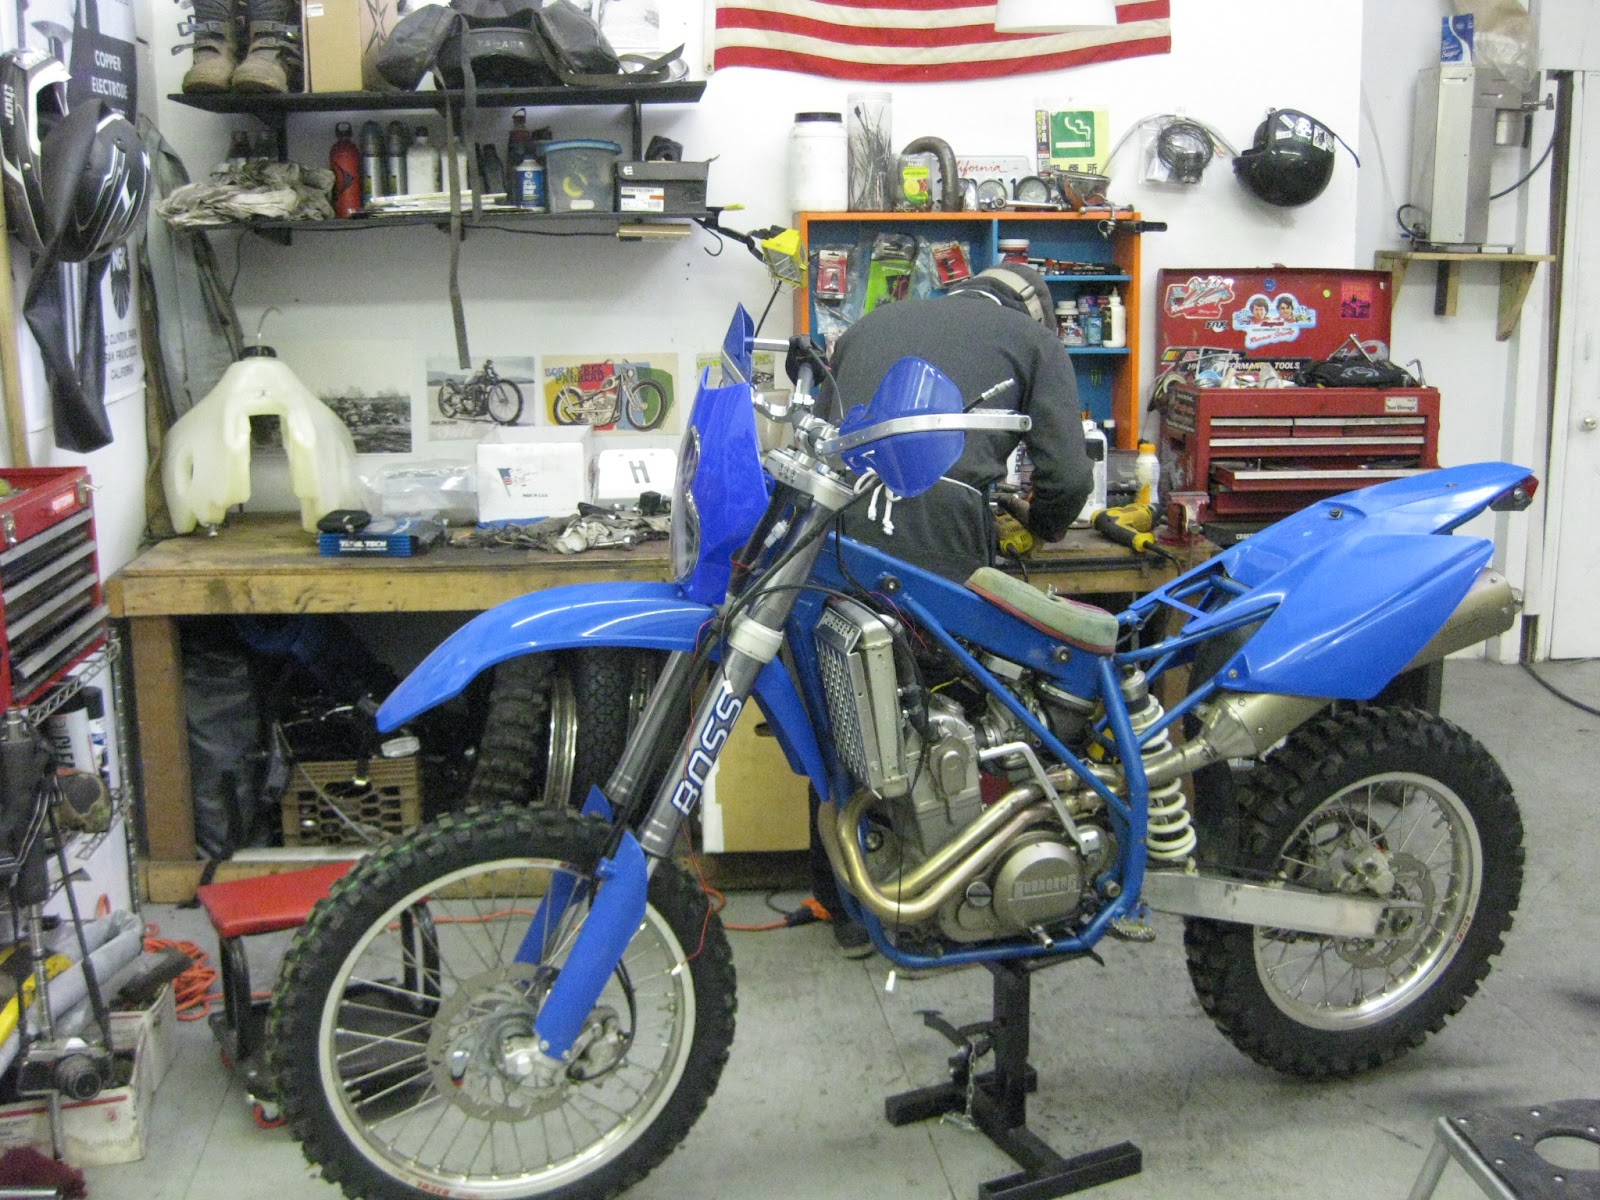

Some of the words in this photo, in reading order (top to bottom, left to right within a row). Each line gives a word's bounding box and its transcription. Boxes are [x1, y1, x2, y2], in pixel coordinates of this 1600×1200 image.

[94, 49, 122, 71] COPPER
[91, 76, 128, 99] ELECTRODE
[956, 160, 1002, 176] lifornia
[1205, 321, 1228, 329] FOX
[1274, 362, 1300, 370] TOOLS
[628, 460, 651, 483] H
[364, 540, 388, 548] TECH
[672, 686, 743, 816] BOSS
